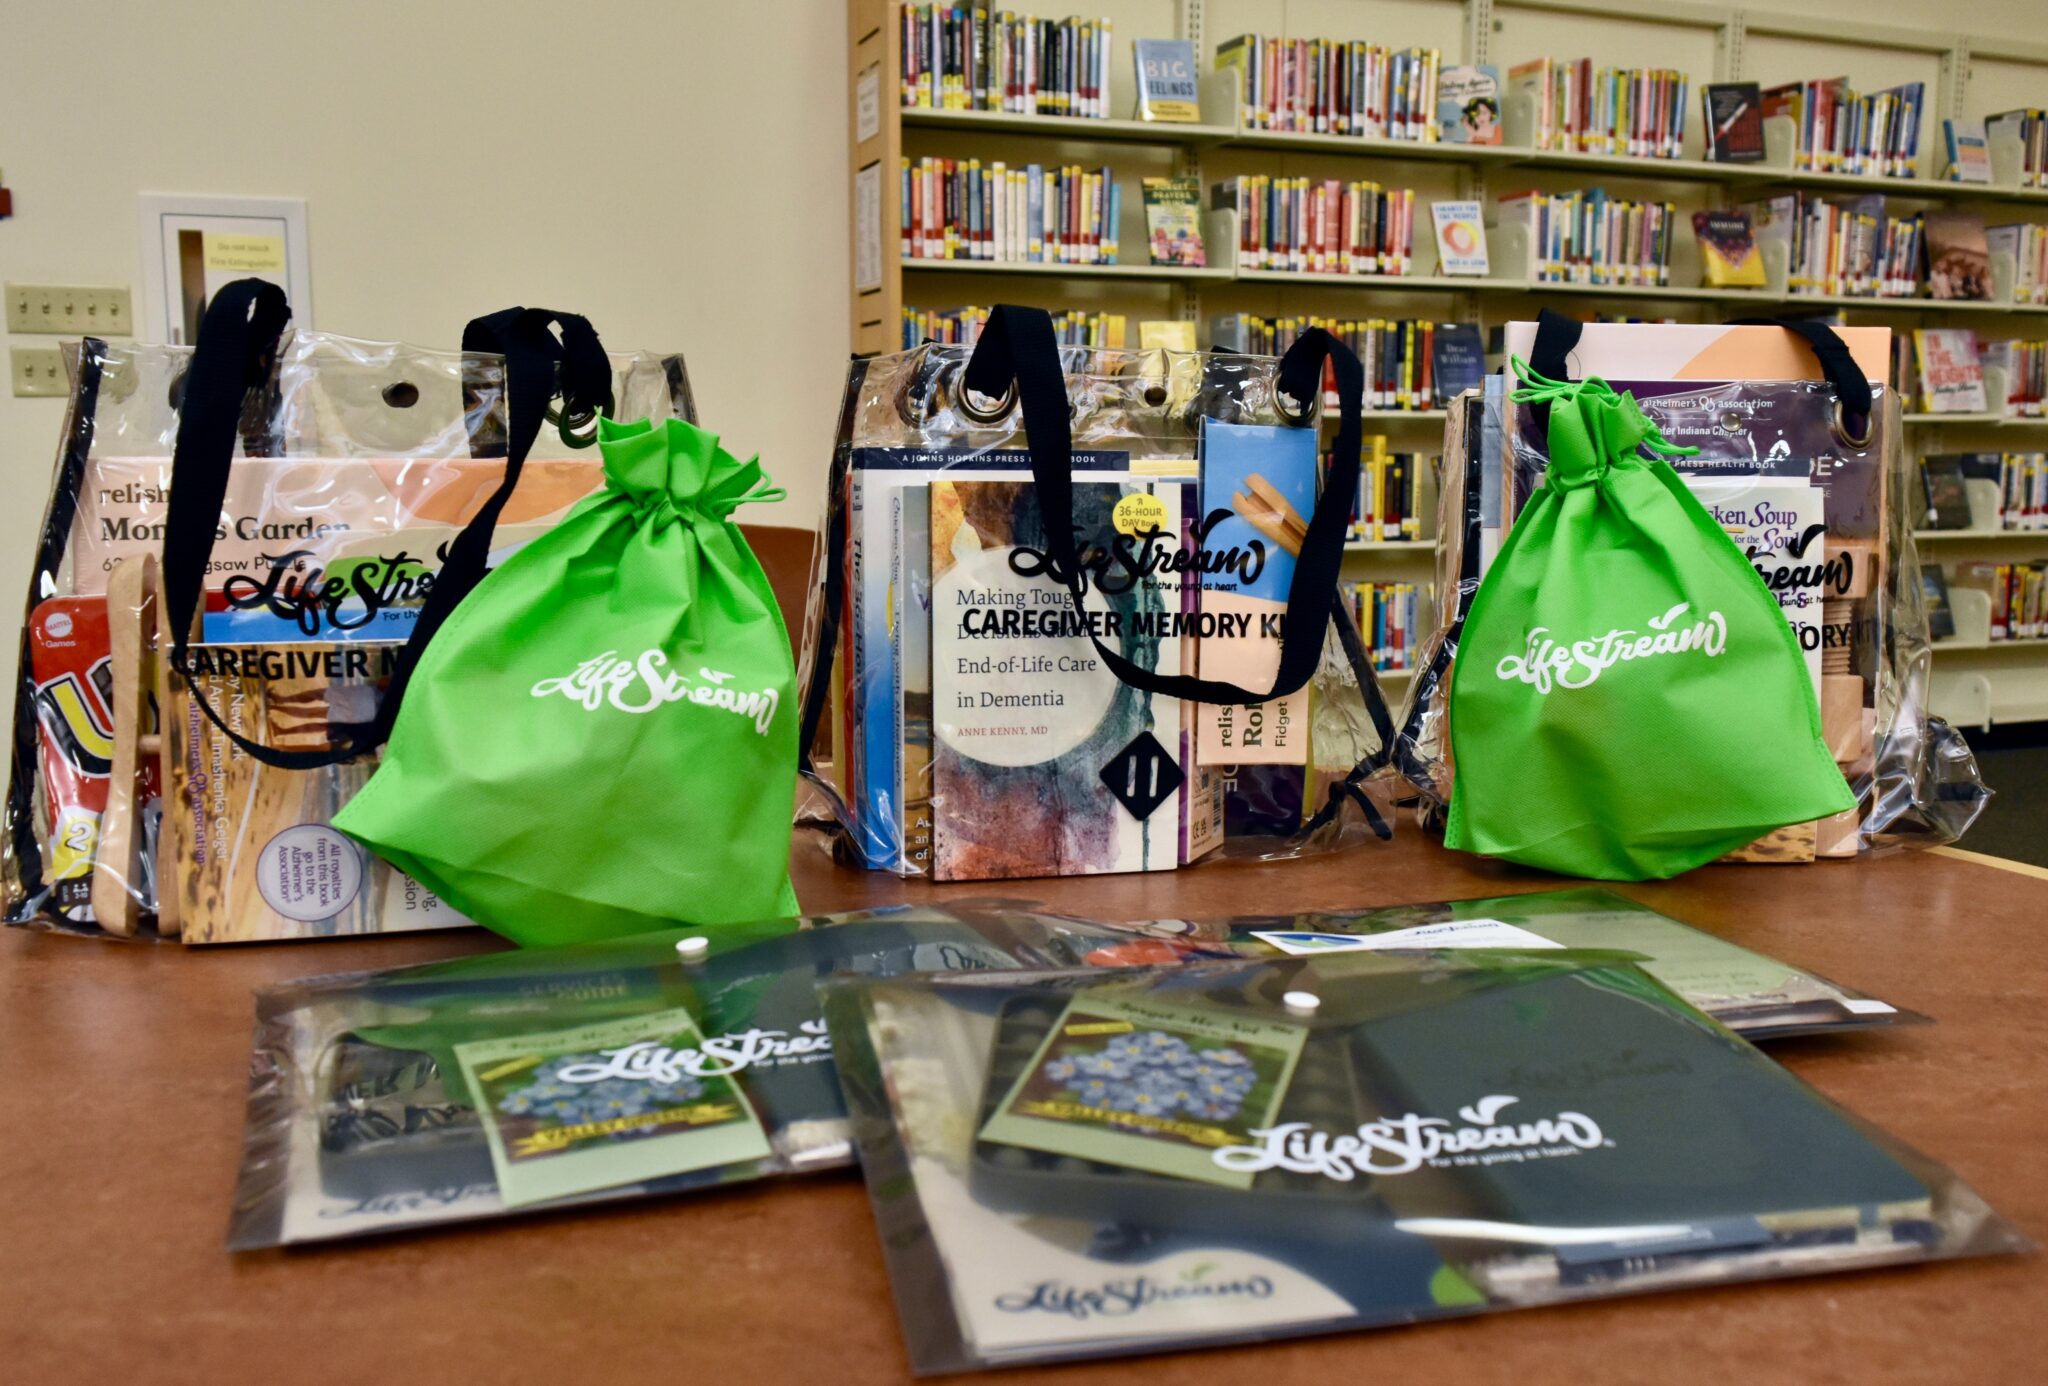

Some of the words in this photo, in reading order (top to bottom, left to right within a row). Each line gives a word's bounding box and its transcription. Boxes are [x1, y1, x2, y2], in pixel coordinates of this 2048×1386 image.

[1147, 60, 1188, 78] BIG
[1643, 399, 1696, 408] alzheimer's
[1677, 426, 1711, 435] Indiana
[912, 454, 945, 463] JOHNS
[948, 454, 992, 463] HOPKINS
[995, 455, 1026, 463] PRESS
[1749, 461, 1776, 469] BOOK
[1119, 506, 1162, 517] 36-HOUR
[1748, 501, 1798, 530] Soup
[235, 516, 351, 541] Garden
[1122, 518, 1139, 528] DAY
[1734, 534, 1746, 544] for
[1746, 534, 1760, 544] the
[1158, 582, 1173, 590] the
[1203, 582, 1213, 591] at
[1215, 582, 1238, 591] heart
[956, 589, 1026, 610] Making
[962, 608, 1123, 638] CAREGIVER
[1131, 613, 1253, 638] MEMORY
[45, 639, 76, 648] Games
[1496, 604, 1728, 695] LifeStream
[957, 655, 1053, 674] End-of-Life
[1057, 656, 1097, 672] Care
[530, 649, 780, 737] LifeStream
[957, 691, 974, 708] in
[980, 689, 1065, 708] Dementia
[957, 727, 988, 737] ANNE
[989, 726, 1028, 737] KENNY,
[1031, 726, 1048, 735] MD
[1217, 704, 1233, 748] relis
[1275, 701, 1291, 747] Fidget
[211, 732, 229, 812] Timashenka
[213, 815, 230, 863] Geiger
[302, 851, 314, 864] go
[317, 837, 329, 861] from
[329, 843, 341, 857] All
[291, 845, 304, 903] Alzheimer's
[305, 866, 315, 878] to
[318, 862, 330, 882] this
[328, 858, 343, 900] royalties
[305, 878, 316, 896] the
[319, 882, 332, 907] book
[1211, 1097, 1604, 1182] LifeStream
[1453, 1154, 1479, 1166] the
[1480, 1150, 1525, 1166] young
